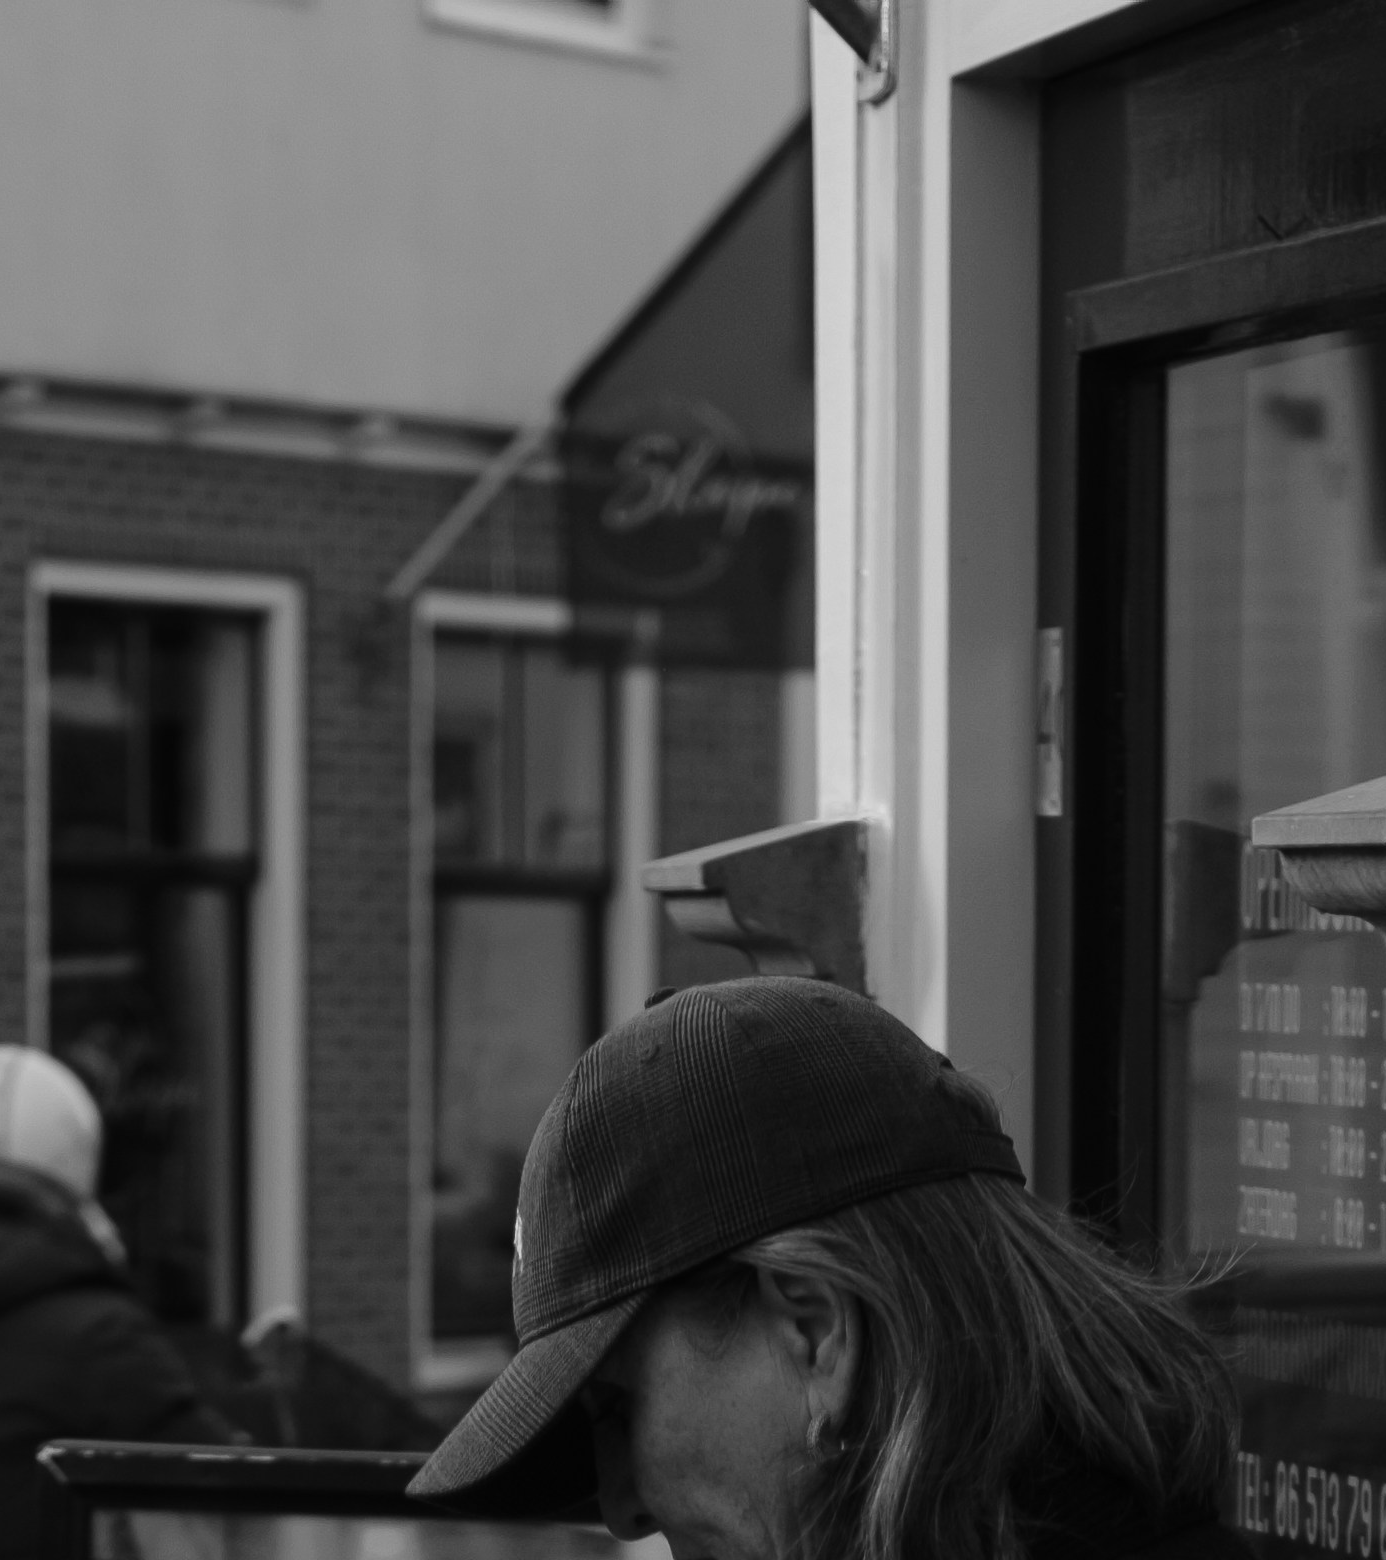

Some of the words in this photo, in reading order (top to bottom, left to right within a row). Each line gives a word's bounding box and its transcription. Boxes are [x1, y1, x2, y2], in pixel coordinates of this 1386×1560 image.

[1235, 1450, 1270, 1534] TEL:
[1274, 1459, 1300, 1540] 06
[1305, 1466, 1340, 1551] 513
[1345, 1474, 1373, 1559] 79
